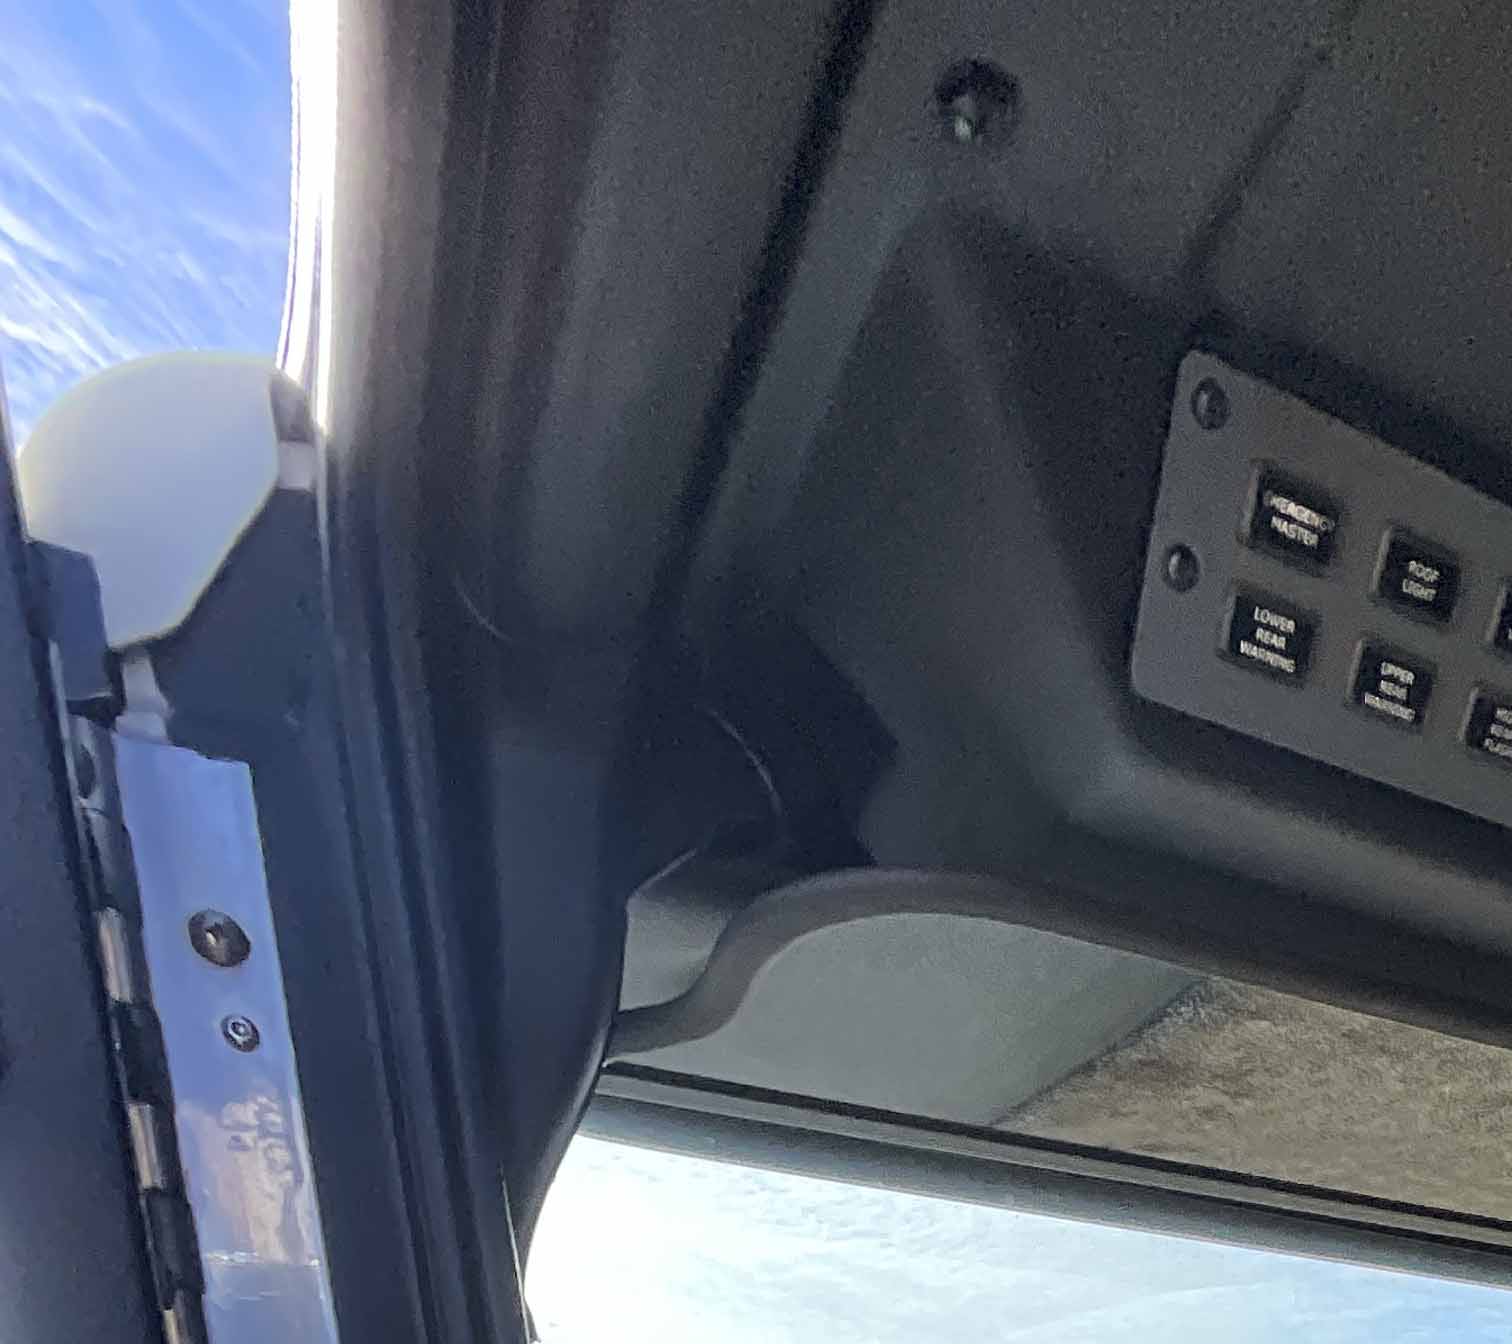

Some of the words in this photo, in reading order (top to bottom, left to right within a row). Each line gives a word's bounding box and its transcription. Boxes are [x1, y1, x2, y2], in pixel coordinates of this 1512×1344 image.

[1271, 516, 1318, 546] MASTER
[1254, 606, 1295, 633] LOWER
[1256, 628, 1286, 649] REAR
[1240, 640, 1295, 673] WARNING
